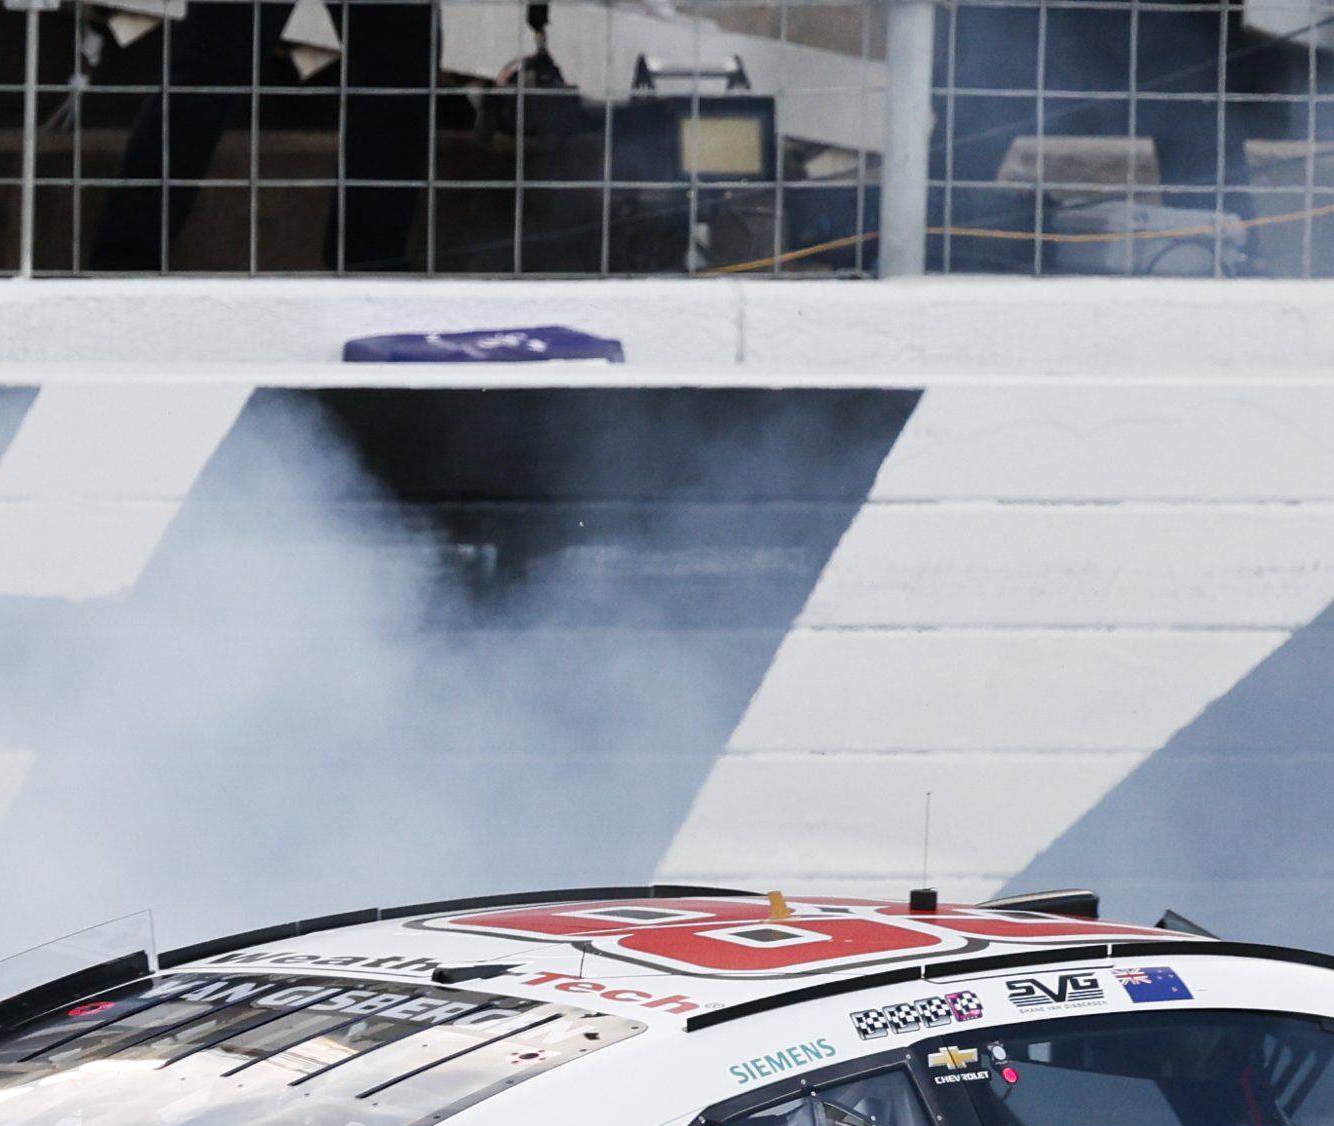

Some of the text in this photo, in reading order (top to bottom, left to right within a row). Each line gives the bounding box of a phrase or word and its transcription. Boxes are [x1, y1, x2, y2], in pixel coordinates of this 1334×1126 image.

[1005, 972, 1100, 1003] SVG
[729, 1038, 837, 1085] SIEMENS
[934, 1070, 989, 1085] CHEVROLET
